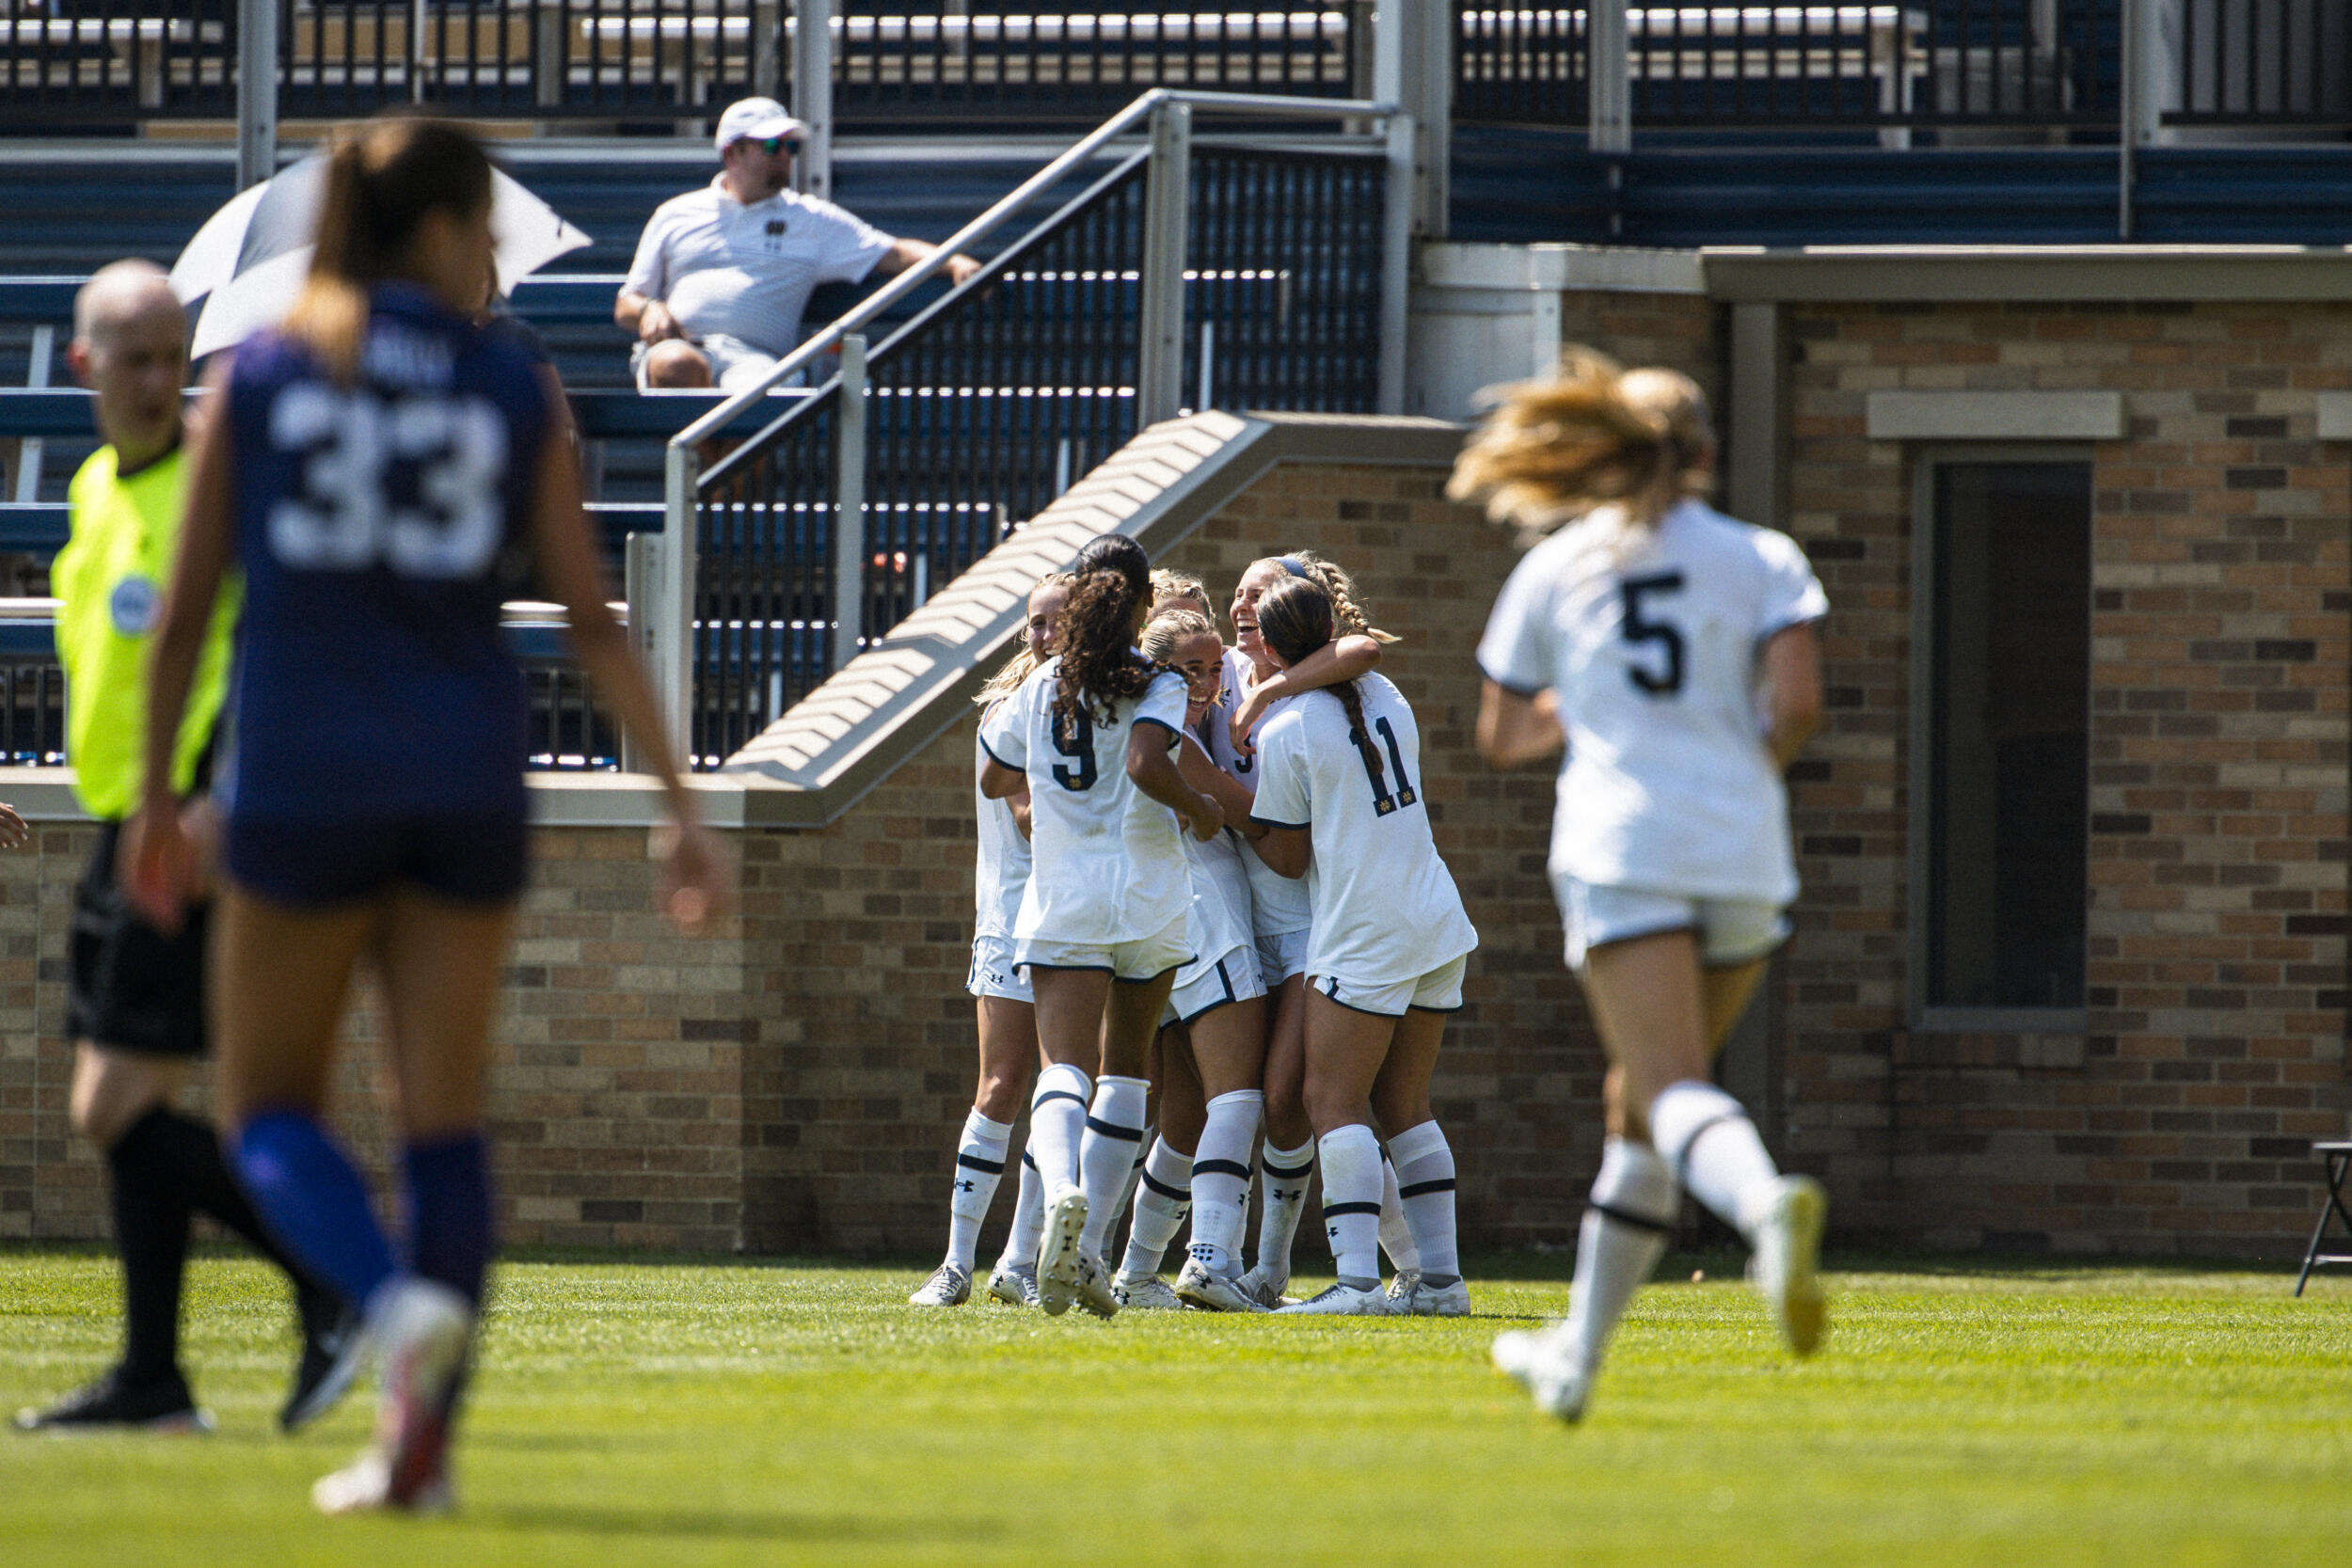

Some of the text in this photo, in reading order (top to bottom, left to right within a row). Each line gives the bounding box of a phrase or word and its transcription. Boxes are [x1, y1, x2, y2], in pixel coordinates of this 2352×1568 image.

[267, 382, 509, 576] 33
[1620, 570, 1686, 696] 5
[1051, 697, 1098, 792] 9
[1348, 716, 1418, 817] 11
